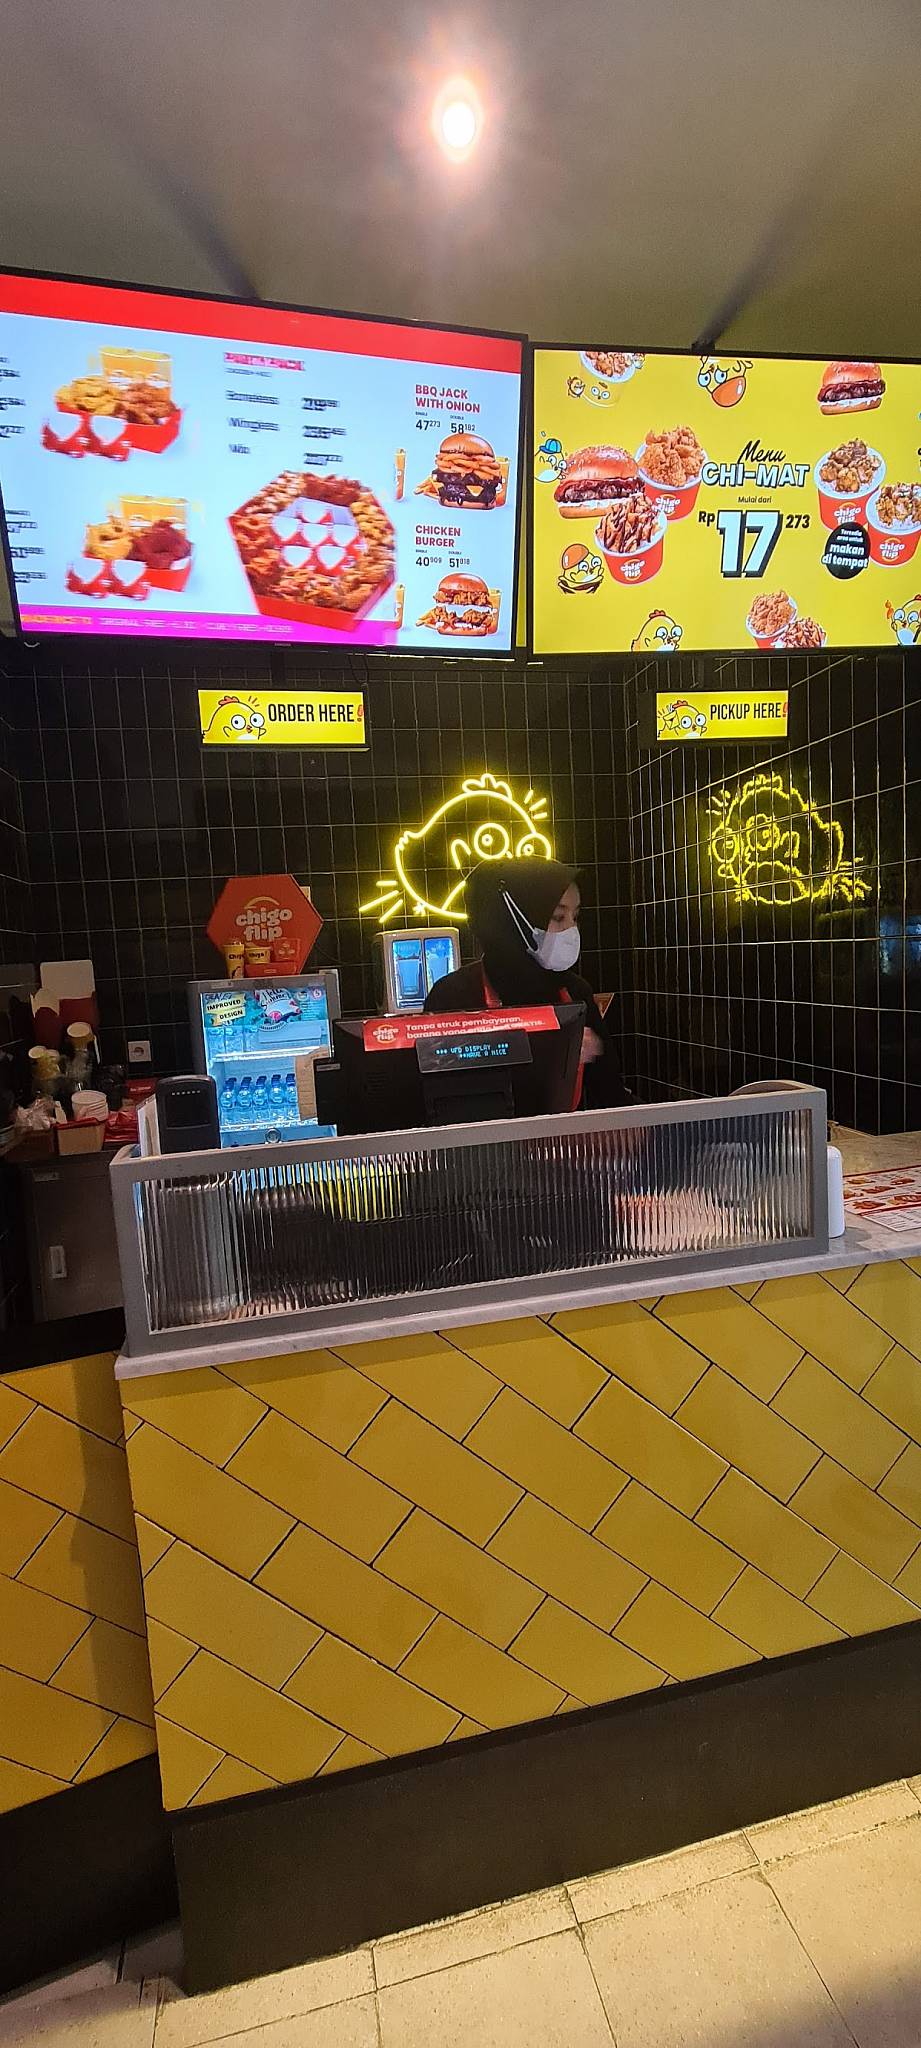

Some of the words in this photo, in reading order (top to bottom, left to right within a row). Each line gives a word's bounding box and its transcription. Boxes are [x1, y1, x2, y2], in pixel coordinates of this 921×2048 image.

[415, 384, 437, 397] BBQ
[440, 387, 468, 400] JACK
[415, 397, 443, 409] WITH
[446, 401, 480, 413] ONION
[738, 440, 786, 464] Menu
[702, 462, 810, 488] CHI-MAT
[738, 495, 756, 503] Mulai
[757, 495, 772, 503] dari
[833, 507, 861, 517] chigo
[415, 525, 461, 536] CHICKEN
[415, 536, 455, 547] BURGER
[699, 511, 715, 527] Rp
[717, 510, 783, 578] 17
[786, 515, 810, 529] 273
[879, 542, 905, 551] chigo
[829, 544, 864, 555] makan
[881, 550, 899, 558] flip
[822, 553, 831, 564] di
[833, 555, 868, 569] tempat
[268, 703, 314, 722] ORDER
[710, 703, 750, 720] PICKUP
[235, 906, 293, 927] chigo
[243, 925, 283, 942] flip
[206, 999, 241, 1011] IMPROVED
[219, 1009, 243, 1020] DESIGN
[405, 1022, 435, 1031] Tanpa
[437, 1020, 461, 1028] struk
[465, 1044, 491, 1052] DISPLAY
